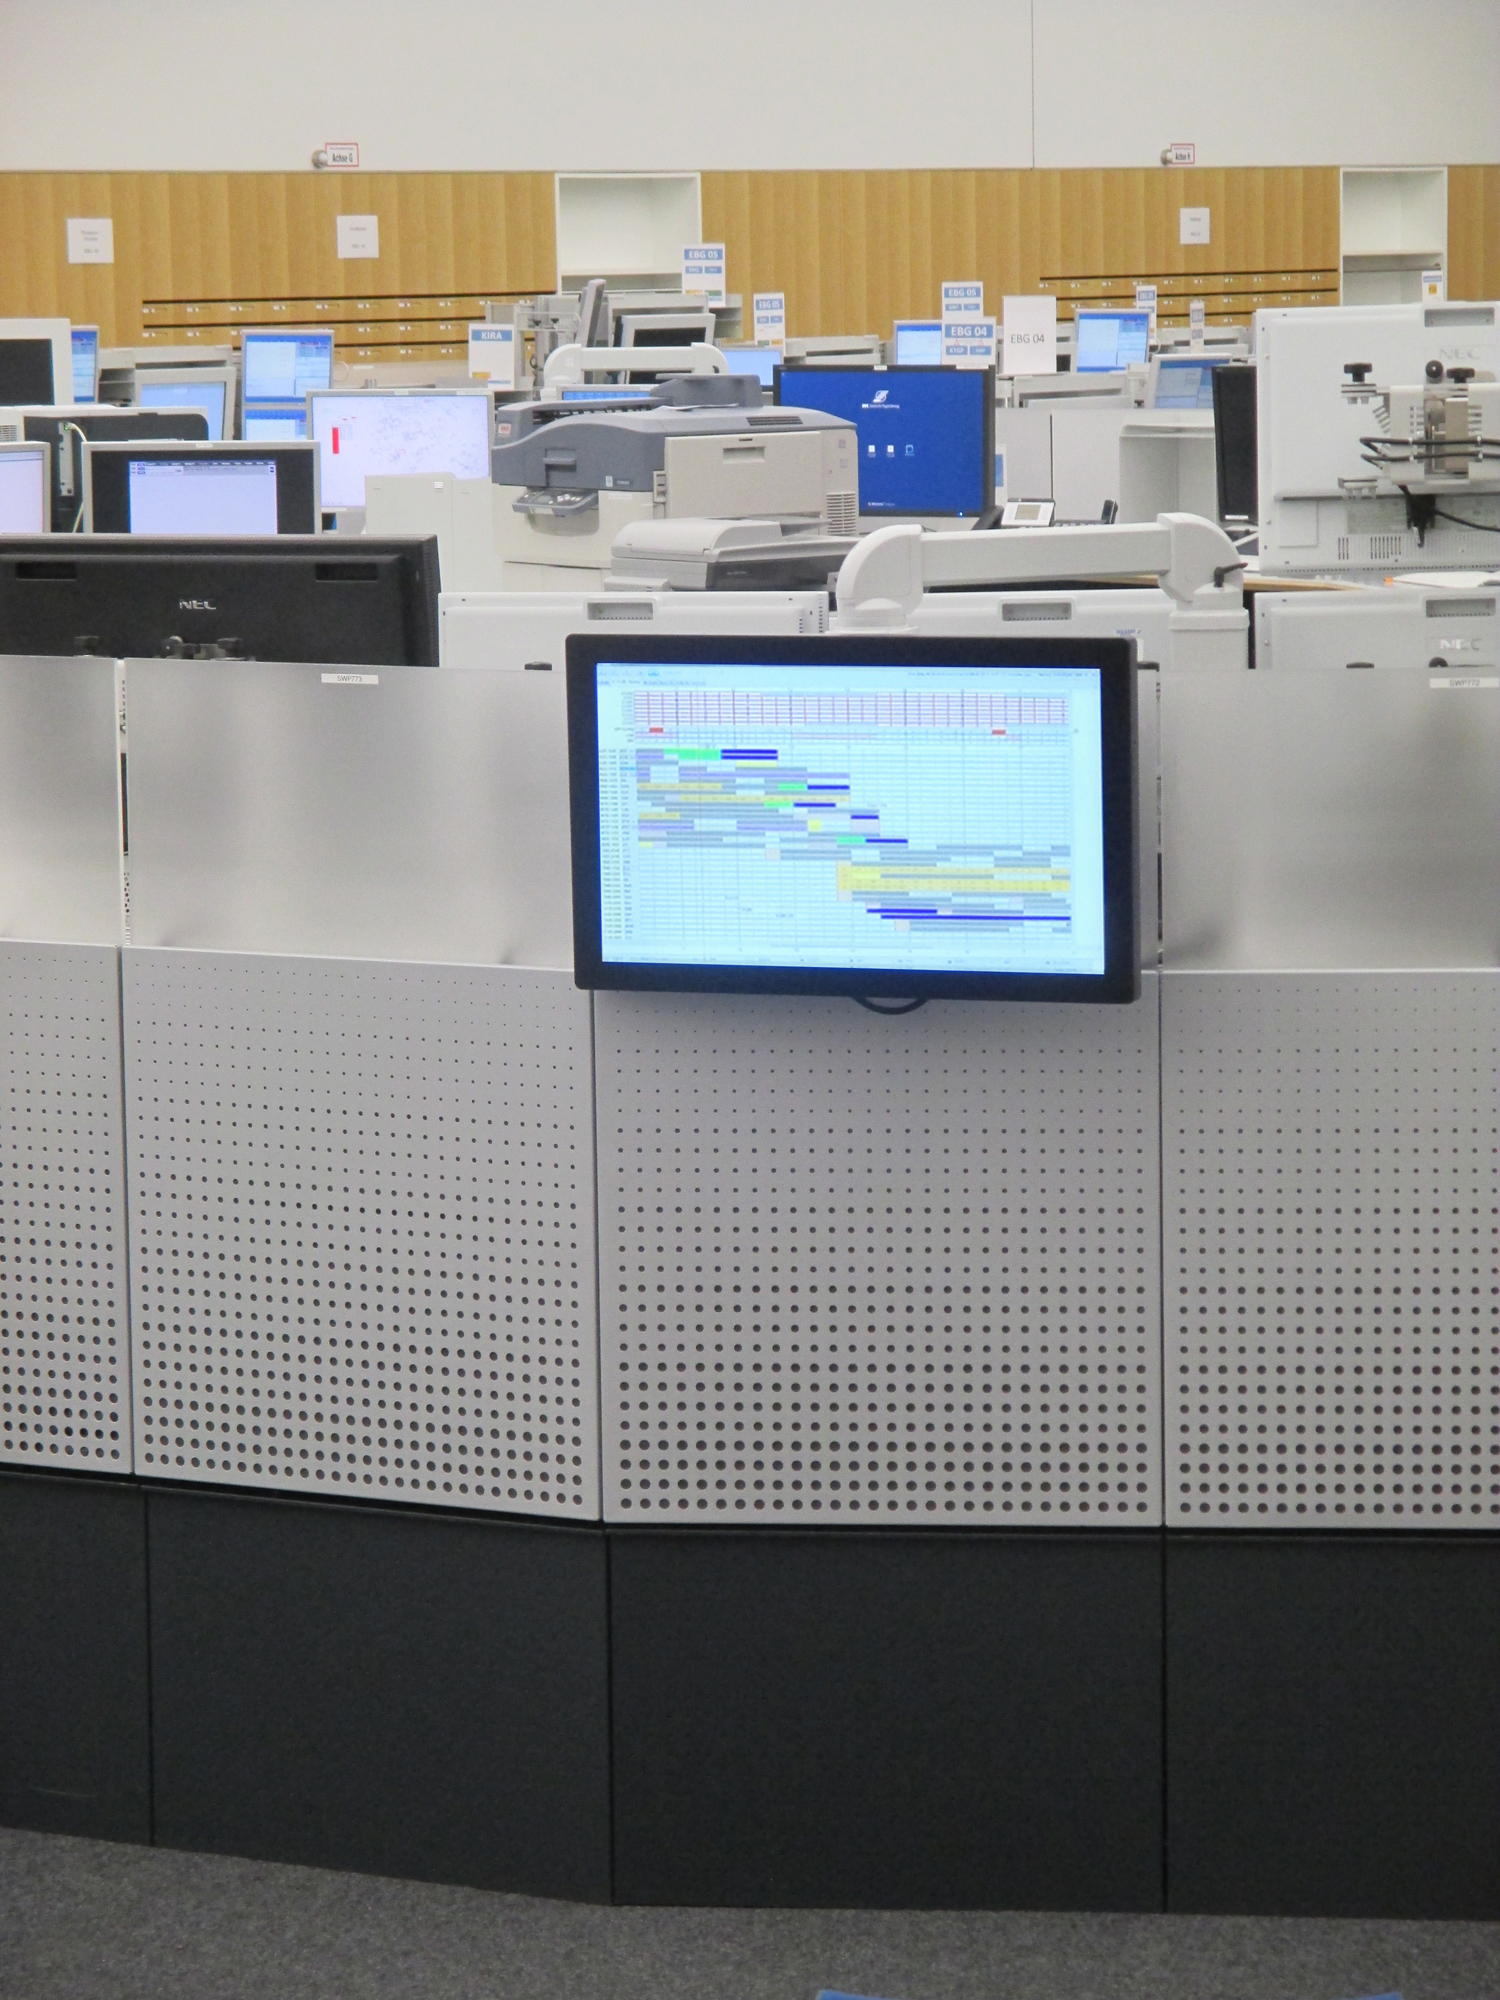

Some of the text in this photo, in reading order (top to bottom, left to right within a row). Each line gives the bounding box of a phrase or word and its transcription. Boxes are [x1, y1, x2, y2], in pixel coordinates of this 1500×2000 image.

[689, 250, 719, 259] EBG 05
[948, 289, 976, 297] EBG 05
[481, 331, 503, 340] KIRA
[951, 326, 988, 336] EBG 04
[1010, 333, 1045, 344] EBG 04
[179, 600, 217, 610] NEC
[1440, 639, 1481, 651] NEC
[336, 674, 363, 683] SWP773
